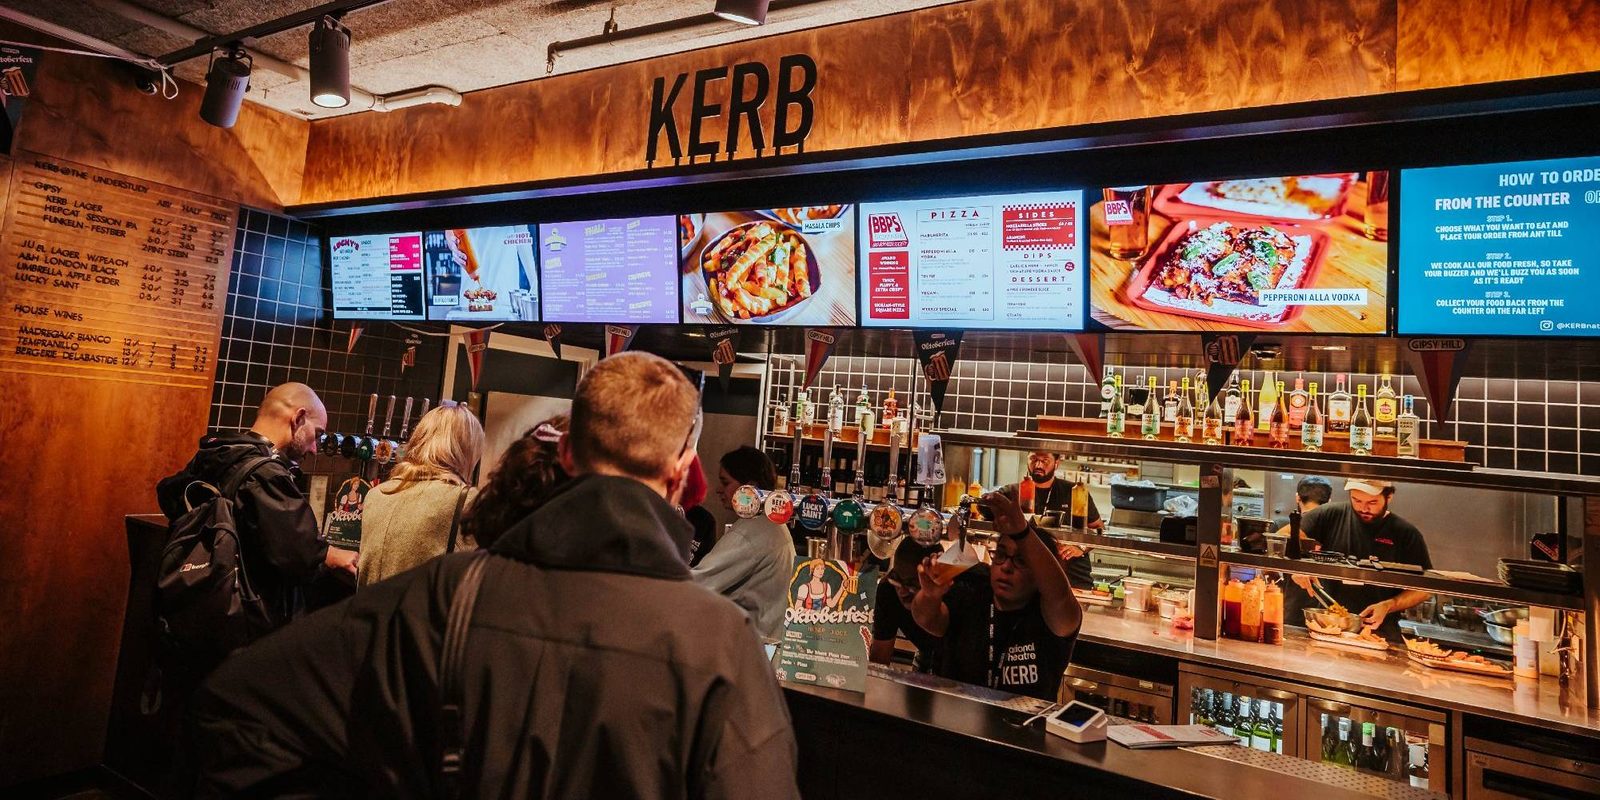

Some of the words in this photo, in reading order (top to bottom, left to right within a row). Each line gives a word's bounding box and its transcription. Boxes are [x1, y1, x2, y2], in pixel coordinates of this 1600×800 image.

[646, 54, 817, 161] KERB
[93, 174, 149, 193] UNDERSTUDY
[1499, 172, 1535, 187] HOW
[1540, 171, 1559, 184] TO
[34, 182, 62, 194] GIPSY
[46, 195, 67, 206] KERB
[74, 201, 103, 213] LAGER
[1435, 198, 1472, 211] FROM
[1475, 196, 1502, 208] THE
[1504, 192, 1570, 208] COUNTER
[1106, 203, 1128, 214] BBPS
[44, 204, 80, 217] HEPCAT
[86, 213, 121, 226] SESSION
[931, 210, 979, 220] PIZZA
[804, 222, 825, 230] MASALA
[872, 214, 902, 234] BBPS
[1435, 226, 1462, 234] CHOOSE
[1463, 224, 1486, 232] WHAT
[1486, 224, 1501, 232] YOU
[1502, 223, 1524, 232] WANT
[1440, 232, 1462, 240] PLACE
[1463, 232, 1482, 240] YOUR
[1483, 231, 1508, 239] ORDER
[1508, 230, 1530, 238] FROM
[1530, 230, 1546, 238] ANY
[1546, 228, 1562, 237] TILL
[51, 246, 80, 260] LAGER
[45, 256, 88, 270] LONDON
[91, 264, 118, 276] BLACK
[1444, 262, 1462, 270] COOK
[1477, 261, 1492, 269] OUR
[1493, 260, 1512, 268] FOOD
[1514, 260, 1540, 270] FRESH,
[1552, 260, 1572, 268] TAKE
[16, 262, 62, 278] UMBRELLA
[67, 271, 92, 282] APPLE
[96, 276, 120, 288] CIDER
[1424, 270, 1442, 278] YOUR
[1444, 270, 1470, 278] BUZZER
[1471, 269, 1486, 277] AND
[1487, 268, 1510, 277] WE'LL
[1512, 268, 1530, 276] BUZZ
[1530, 268, 1545, 276] YOU
[1546, 268, 1557, 276] AS
[1558, 268, 1580, 276] SOON
[15, 272, 49, 285] LUCKY
[53, 280, 80, 290] SAINT
[1500, 276, 1524, 284] READY
[1262, 292, 1308, 302] PEPPERONI
[1309, 292, 1330, 302] ALLA
[1331, 292, 1361, 302] VODKA
[1436, 299, 1466, 307] COLLECT
[1466, 299, 1486, 307] YOUR
[1486, 299, 1506, 307] FOOD
[1506, 299, 1526, 307] BACK
[1528, 299, 1550, 307] FROM
[1550, 299, 1564, 307] THE
[14, 304, 49, 316] HOUSE
[54, 310, 83, 322] WINES
[1486, 307, 1496, 315] ON
[1498, 307, 1512, 315] THE
[1512, 307, 1526, 315] FAR
[1528, 307, 1546, 315] LEFT
[17, 336, 79, 351] TEMPRANILLO
[77, 333, 111, 345] BIANCO
[921, 340, 956, 350] Oktoberfest
[1411, 340, 1438, 349] GIPSY
[1441, 340, 1461, 349] HILL
[15, 346, 57, 360] BERGERIE
[63, 351, 118, 366] DELABASTIDE
[802, 504, 824, 513] LUCKY
[785, 604, 874, 624] Oktoberfest
[1008, 643, 1035, 654] ational
[1008, 652, 1036, 662] heatre
[1002, 664, 1038, 684] KERB
